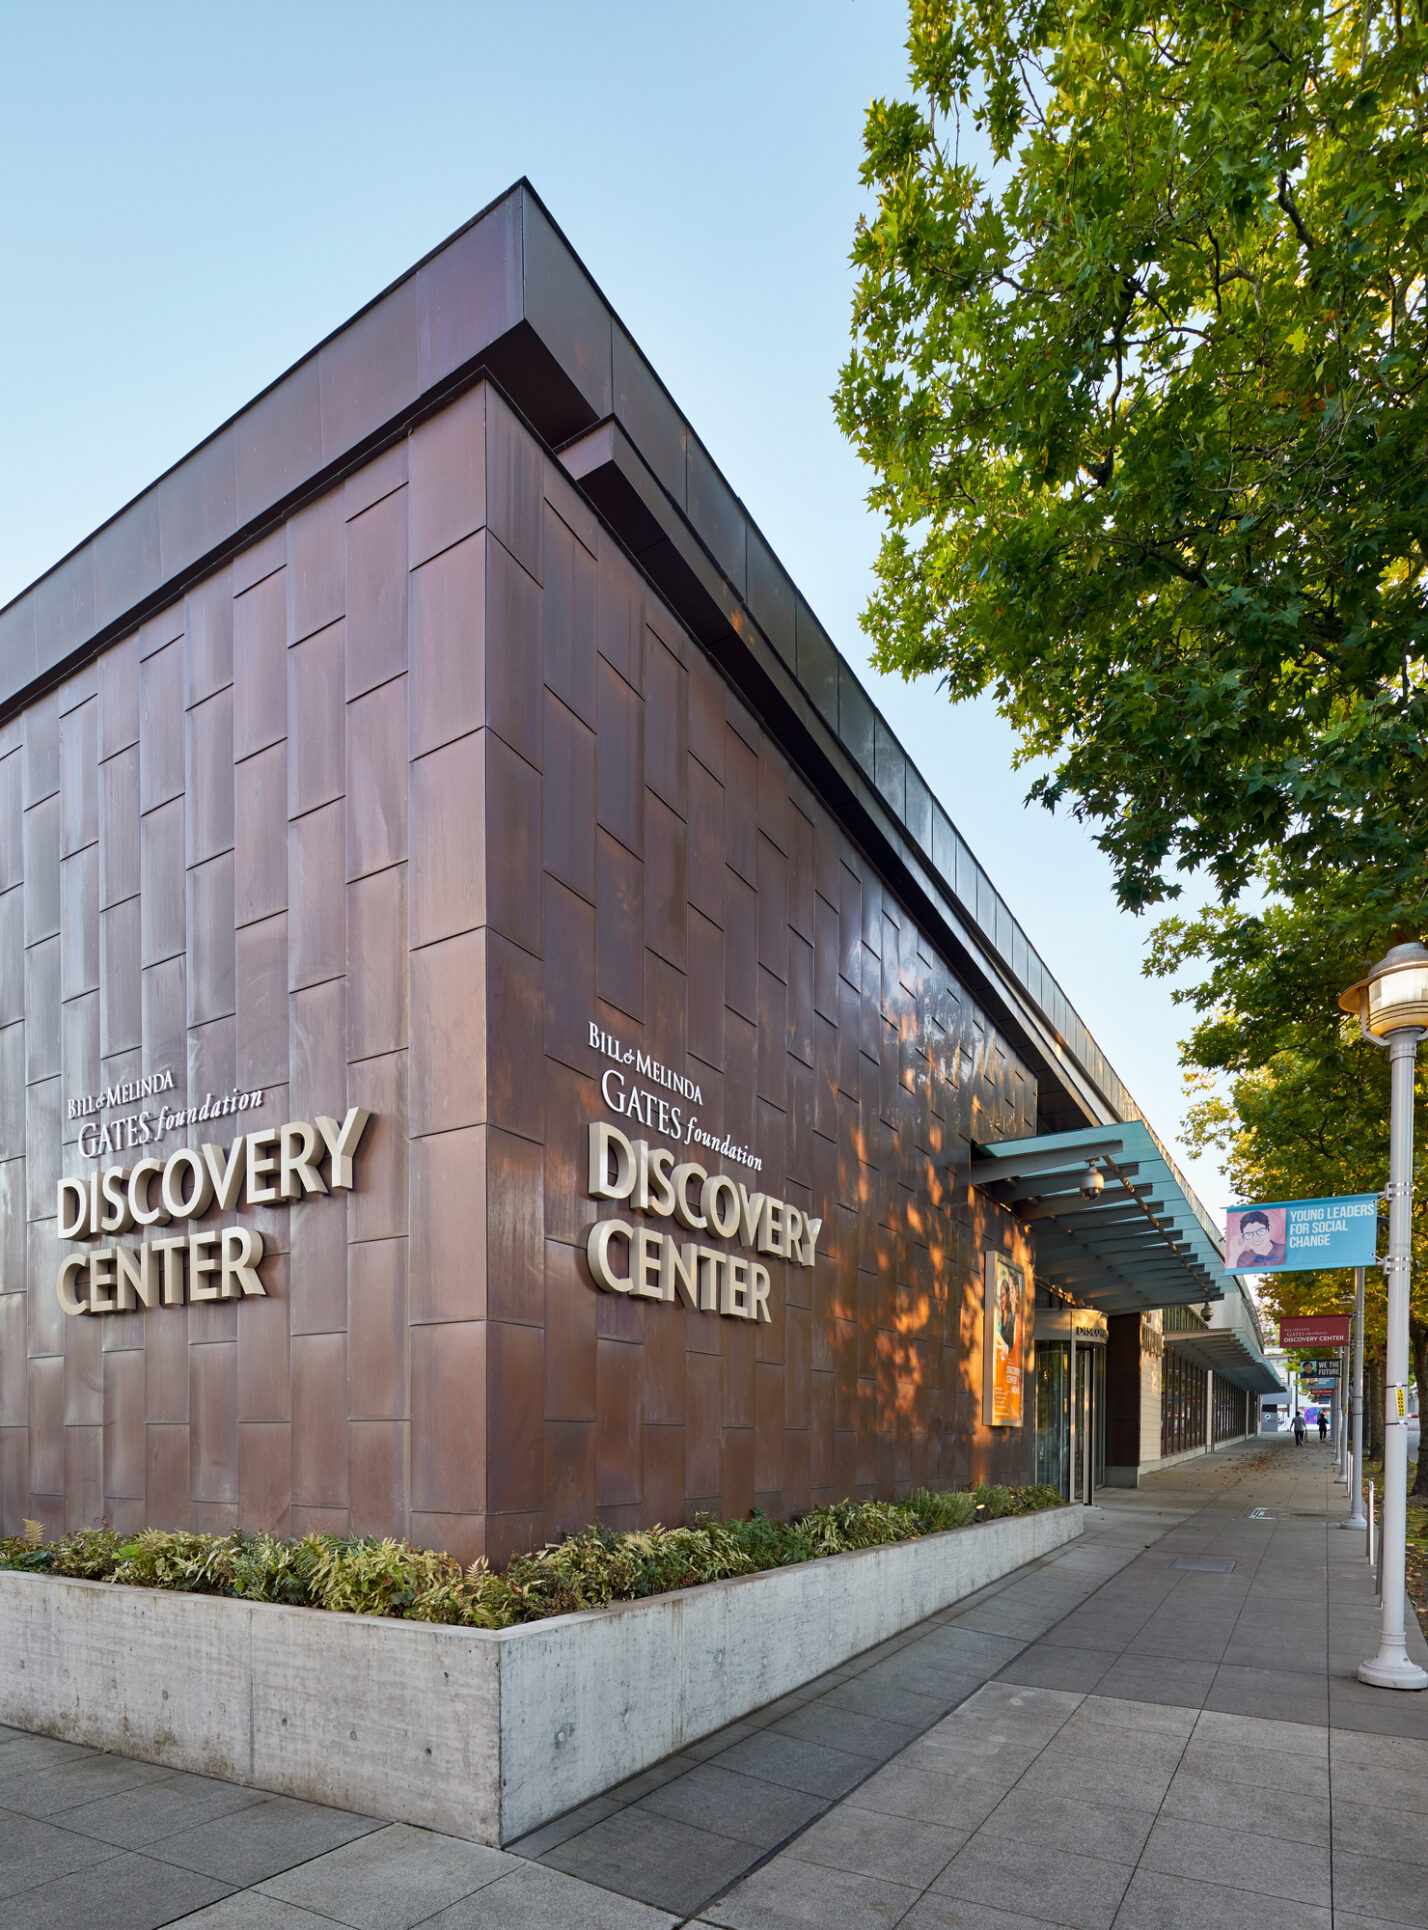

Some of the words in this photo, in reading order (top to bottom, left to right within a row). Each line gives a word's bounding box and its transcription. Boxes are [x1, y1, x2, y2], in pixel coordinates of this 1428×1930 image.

[78, 1111, 150, 1158] GATES
[153, 1088, 263, 1142] foundation
[601, 1069, 681, 1140] GATES
[684, 1117, 762, 1171] foundation
[57, 1106, 373, 1241] DISCOVERY
[588, 1121, 823, 1267] DISCOVERY
[1290, 1208, 1325, 1222] YOUNG
[1327, 1204, 1375, 1219] LEADERS
[1290, 1223, 1310, 1236] FOR
[1312, 1220, 1348, 1234] SOCIAL
[1290, 1234, 1331, 1248] CHANGE
[56, 1226, 267, 1316] CENTER
[587, 1219, 772, 1323] CENTER
[1319, 1368, 1340, 1376] FUTURE
